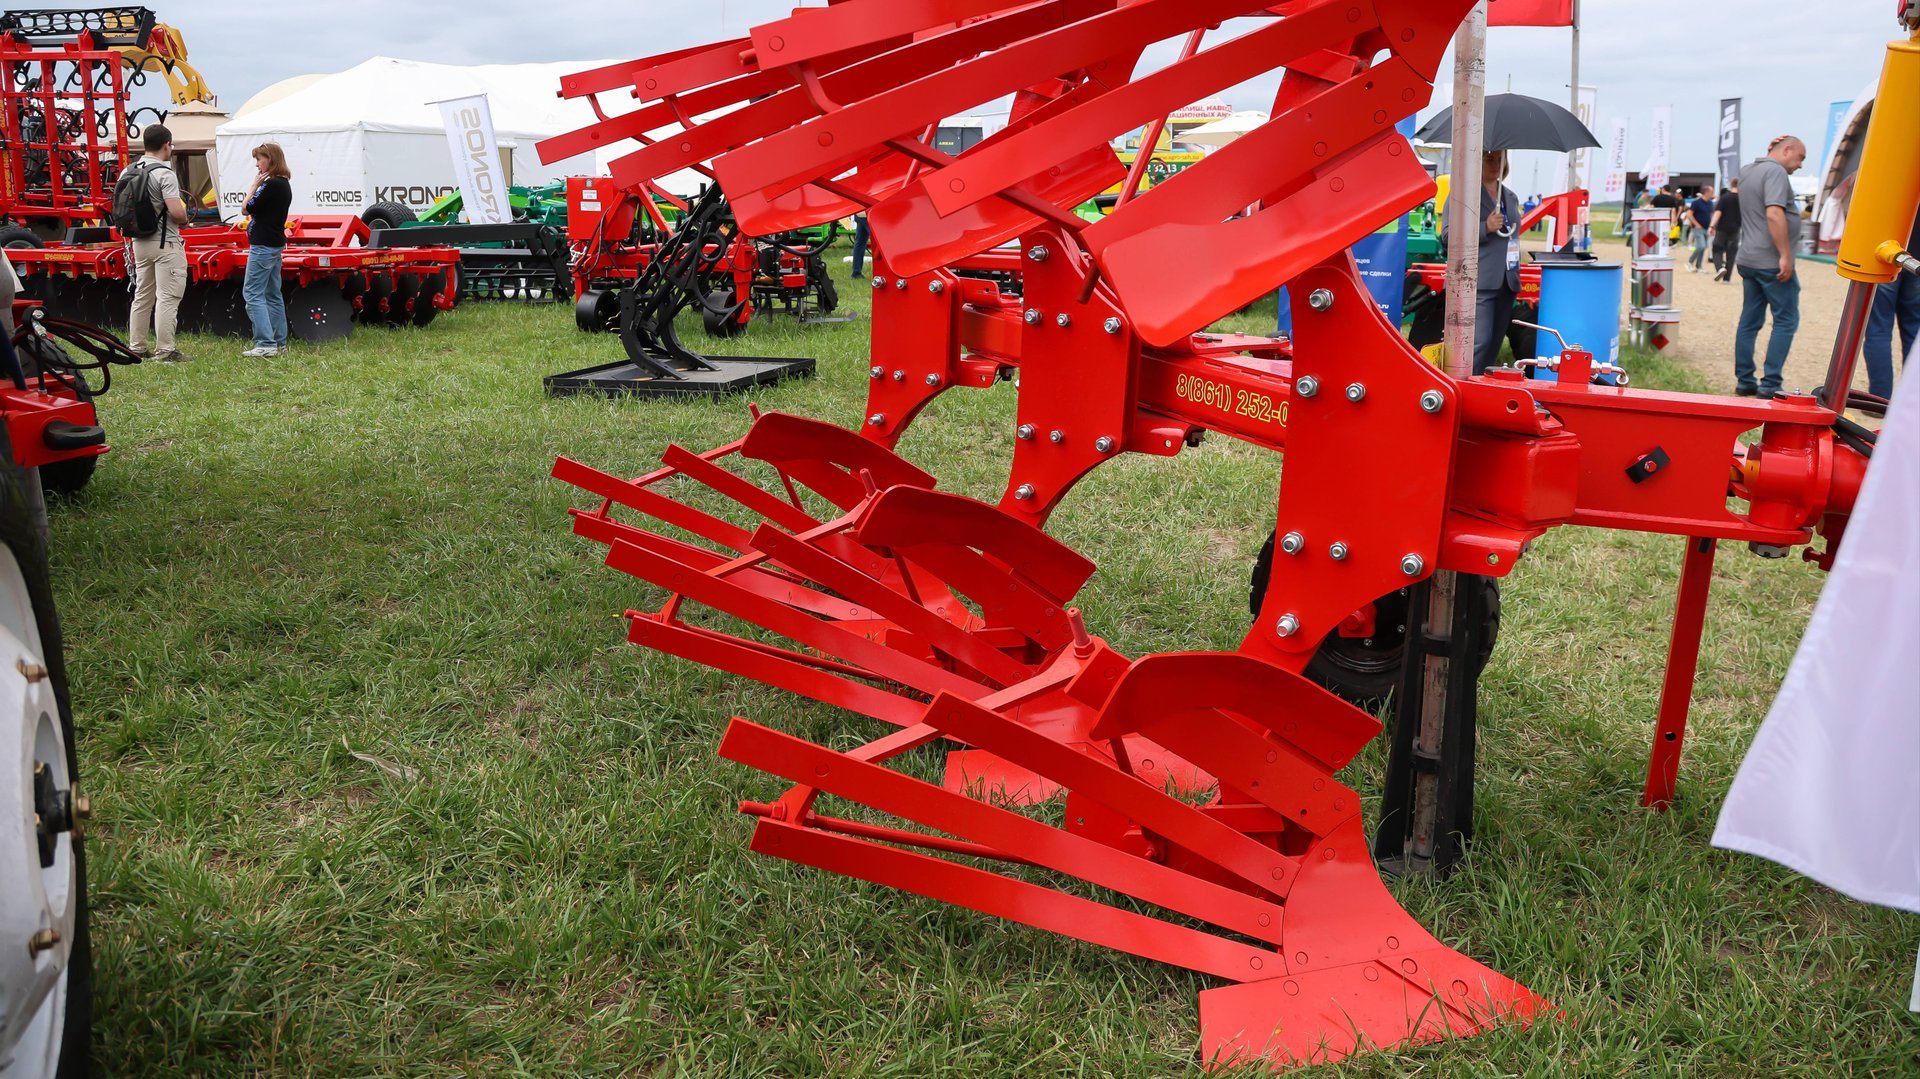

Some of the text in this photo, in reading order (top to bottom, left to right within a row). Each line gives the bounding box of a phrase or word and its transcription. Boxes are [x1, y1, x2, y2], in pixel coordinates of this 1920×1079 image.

[315, 190, 362, 202] KRONOS
[375, 186, 461, 205] KRONO
[1175, 373, 1232, 412] 8(861)
